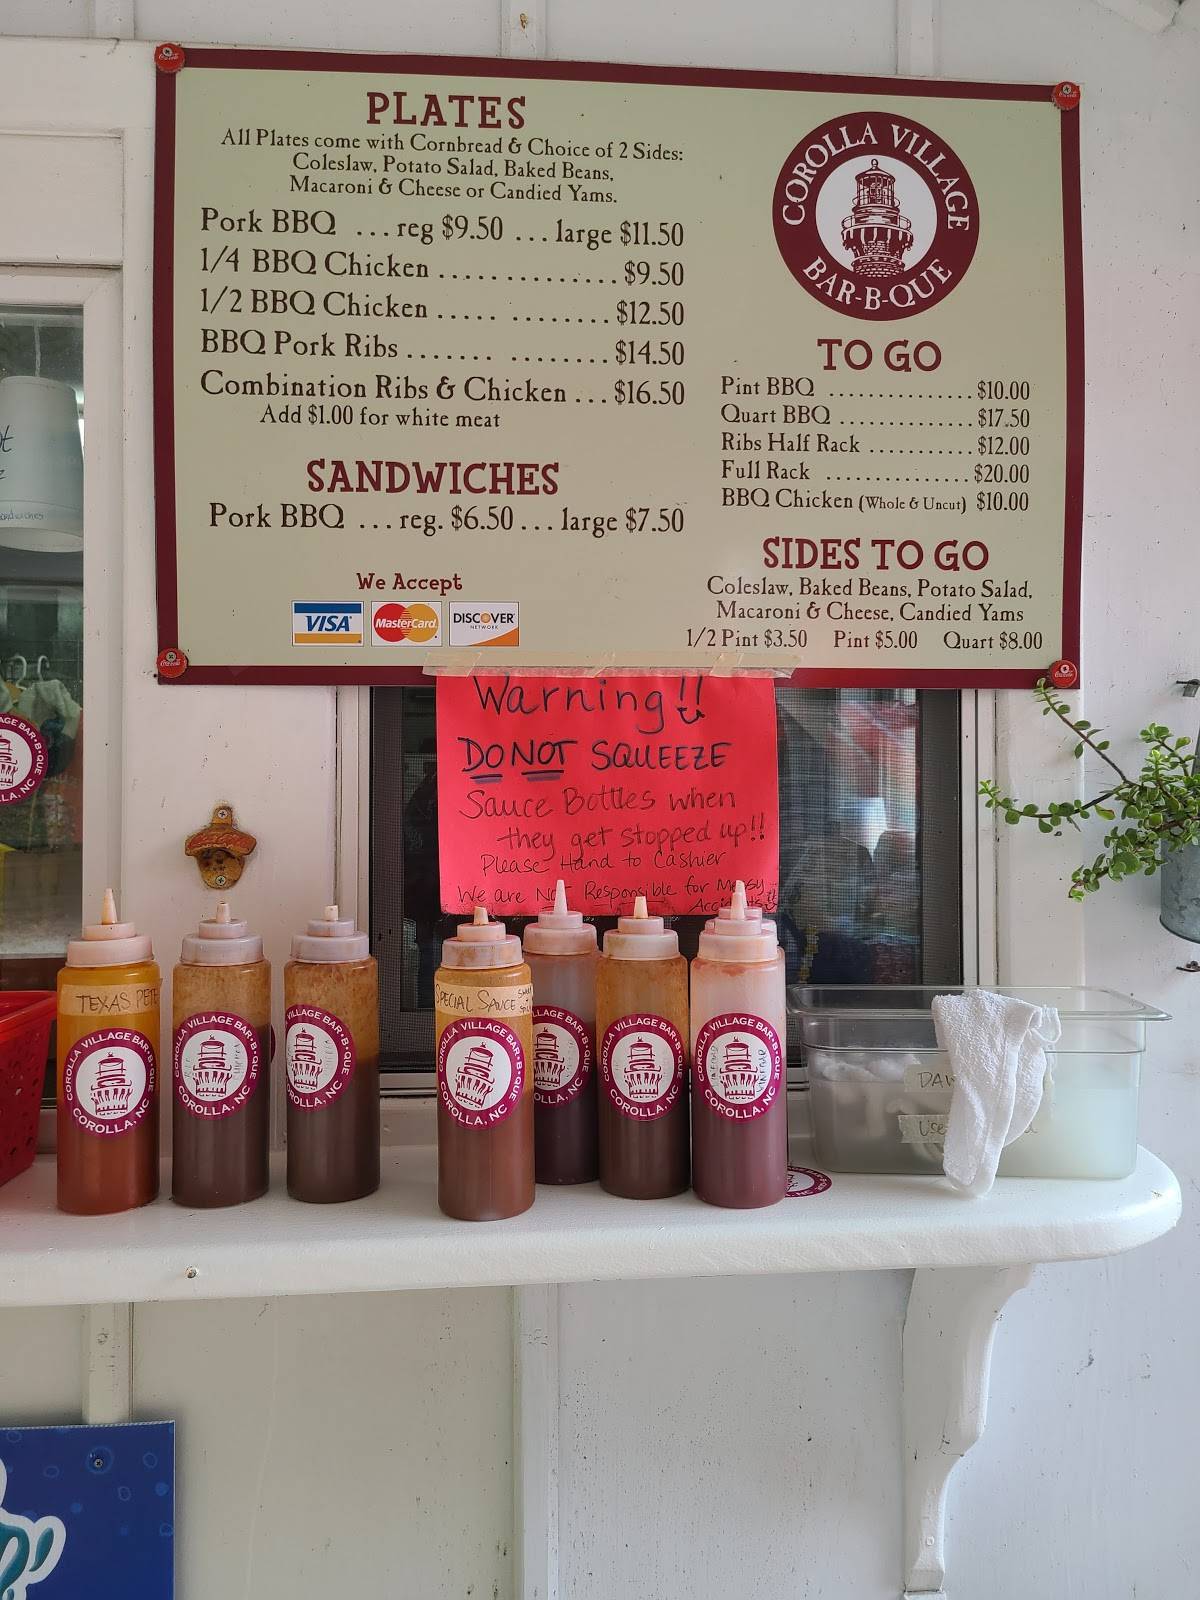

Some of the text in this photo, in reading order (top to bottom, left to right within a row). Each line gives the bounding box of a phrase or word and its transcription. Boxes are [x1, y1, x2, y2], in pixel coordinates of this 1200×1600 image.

[367, 92, 525, 129] PLATES
[221, 128, 683, 160] All Plates come with Cornbread & Choice of 2 Sides:
[293, 152, 613, 182] Coleslaw, Potato Salad, Baked Beans,
[782, 121, 969, 232] COROLLA VILLAGE
[289, 175, 617, 203] Macaroni & Cheese or Candied Yams.
[201, 207, 683, 251] Pork BBQ reg $9.50 large $11.50
[201, 245, 684, 286] 1/4 BBQ Chicken $9.50
[802, 256, 953, 311] BAR-B-QUE
[201, 286, 684, 326] 1/2 BBQ Chicken $12.50
[201, 328, 684, 365] BBQ Pork Ribs $14.50
[817, 339, 941, 372] TO GO
[201, 370, 684, 405] Combination Ribs & Chicken $16.50
[721, 376, 1029, 400] Pint BBQ $10.00
[260, 404, 500, 427] Add $1.00 for white meat
[721, 404, 1029, 428] Quart BBQ $17.50
[722, 432, 1029, 456] Ribs Half Rack $12.00
[307, 458, 559, 495] SANDWICHES
[721, 460, 1029, 484] Full Rack $20.00
[722, 488, 1028, 515] BBQ Chicken (Whole & Uncut) $10.00
[209, 503, 684, 538] Pork BBQ reg. $6.50 large $7.50
[763, 536, 989, 571] SIDES TO GO
[356, 573, 462, 596] We Accept
[707, 576, 1032, 599] Coleslaw, Baked Beans, Potato Salad,
[306, 615, 350, 632] VISA
[374, 617, 438, 629] MasterCard
[453, 612, 514, 624] DISCOVER
[717, 600, 1023, 621] Macaroni & Cheese, Candied Yams
[687, 627, 1042, 650] 1/2 Pint $3.50 Pint $5.00 Quart $8.00
[591, 740, 733, 770] SQUEEZE
[20, 778, 35, 794] NC
[459, 785, 736, 820] Sauce Bottles when
[497, 827, 557, 862] they
[571, 827, 613, 858] get
[621, 819, 713, 851] stopped
[480, 850, 727, 877] Please Hand to Cashier
[457, 875, 709, 908] We are Responsible for
[75, 992, 131, 1014] TEXAS
[436, 984, 473, 1013] SPECIAL
[477, 989, 516, 1013] SAUCE
[187, 1015, 233, 1028] VILLAGE
[461, 1021, 508, 1038] VILLAGE
[614, 1017, 659, 1032] VILLAGE
[709, 1017, 755, 1031] VILLAGE
[81, 1032, 132, 1048] VILLAGE
[178, 1085, 250, 1115] COROLLA, NC
[326, 1080, 343, 1099] NC
[440, 1081, 508, 1126] COROLLA, NC
[610, 1084, 679, 1117] COROLLA, NC
[705, 1086, 776, 1119] COROLLA, NC
[73, 1098, 149, 1134] COROLLA, NC
